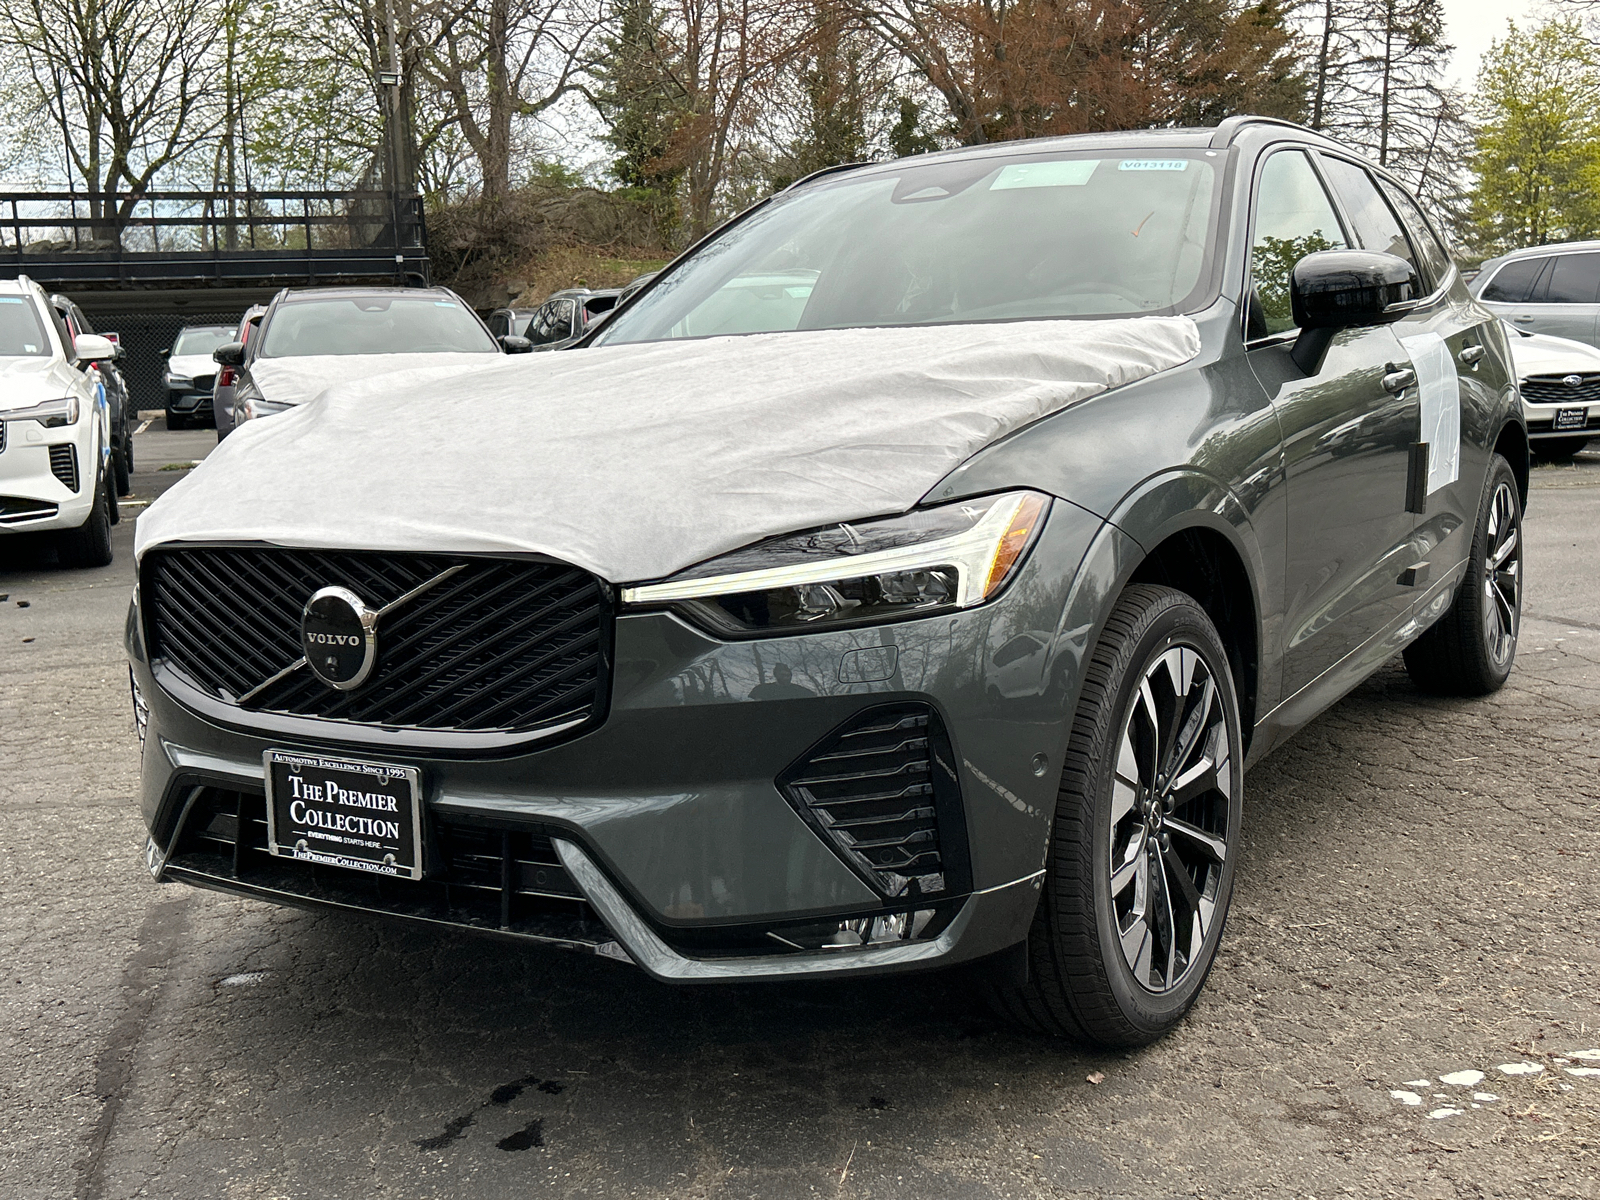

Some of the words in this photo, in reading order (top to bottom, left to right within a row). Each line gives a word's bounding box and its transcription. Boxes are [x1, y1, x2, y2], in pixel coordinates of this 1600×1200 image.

[1124, 161, 1182, 169] V013118
[306, 632, 360, 646] VOLVO
[274, 753, 319, 766] AUTOMOTIVE
[318, 759, 361, 772] EXCELLENCE
[362, 764, 384, 775] SINCE
[385, 767, 406, 778] 1995
[288, 775, 324, 802] THE
[324, 780, 399, 812] PREMIER
[290, 800, 400, 839] COLLECTION
[307, 830, 343, 843] EVERYTHING
[343, 837, 365, 847] STARTS
[292, 849, 398, 875] THEPREMIERCOLLECTION.COM
